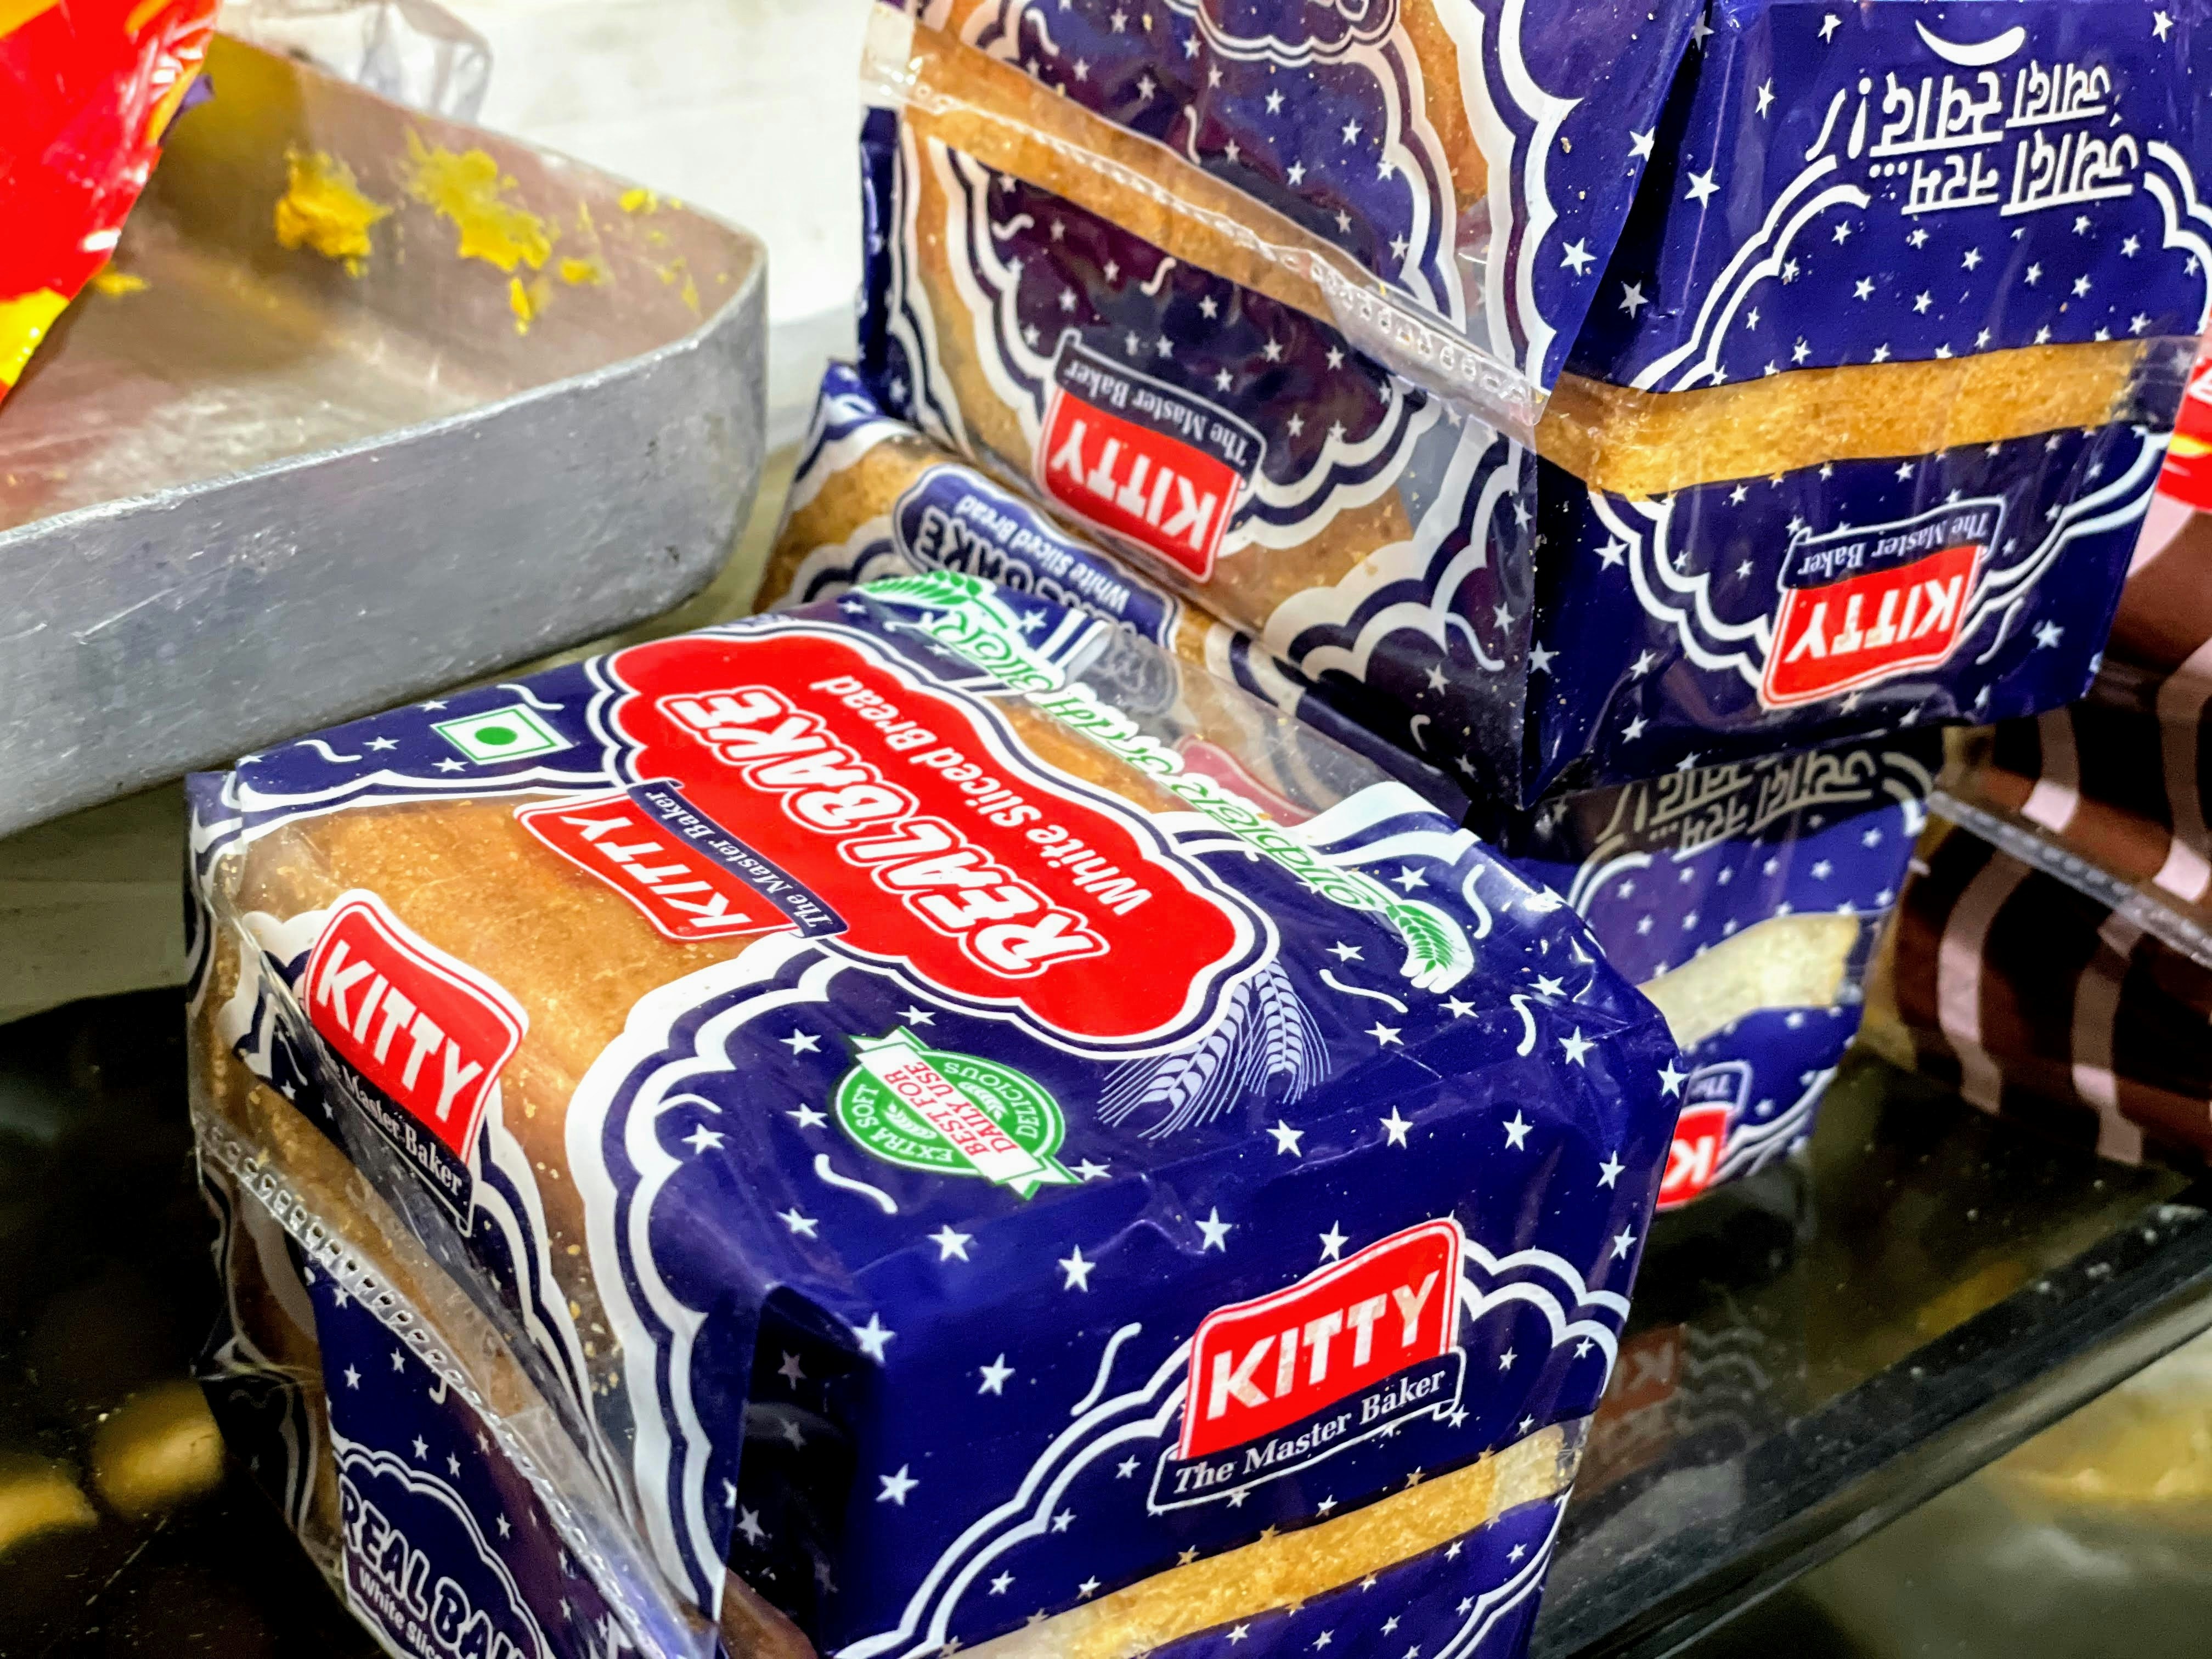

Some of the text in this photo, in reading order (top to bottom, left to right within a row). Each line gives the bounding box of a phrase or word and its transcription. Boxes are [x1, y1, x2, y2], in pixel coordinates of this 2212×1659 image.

[2005, 59, 2111, 128] ज्यादा
[2000, 128, 2139, 217] ज्यादा
[1064, 359, 1251, 466] The Master Baker
[1050, 419, 1217, 552] KITTY
[954, 494, 1131, 615] White Sliced Bread
[1797, 511, 1990, 578] The Master Baker
[932, 610, 1053, 692] आहार
[1783, 574, 1964, 664] KITTY
[1042, 696, 1173, 775] उत्तम
[809, 675, 1152, 916] White Sliced Bread
[560, 815, 753, 928] KITTY
[645, 792, 831, 929] The Master Baker
[1171, 781, 1376, 908] शाकाहार
[315, 939, 484, 1122] KITTY
[851, 1084, 953, 1163] EXTRA SOFT
[883, 1069, 992, 1157] BEST FOR
[902, 1060, 1019, 1154] DAILY USE
[944, 1062, 1040, 1139] DELICIOUS
[404, 1121, 463, 1197] Baker
[1206, 1269, 1440, 1421] KITTY
[1172, 1369, 1446, 1494] The Master Baker
[359, 1565, 405, 1630] White
